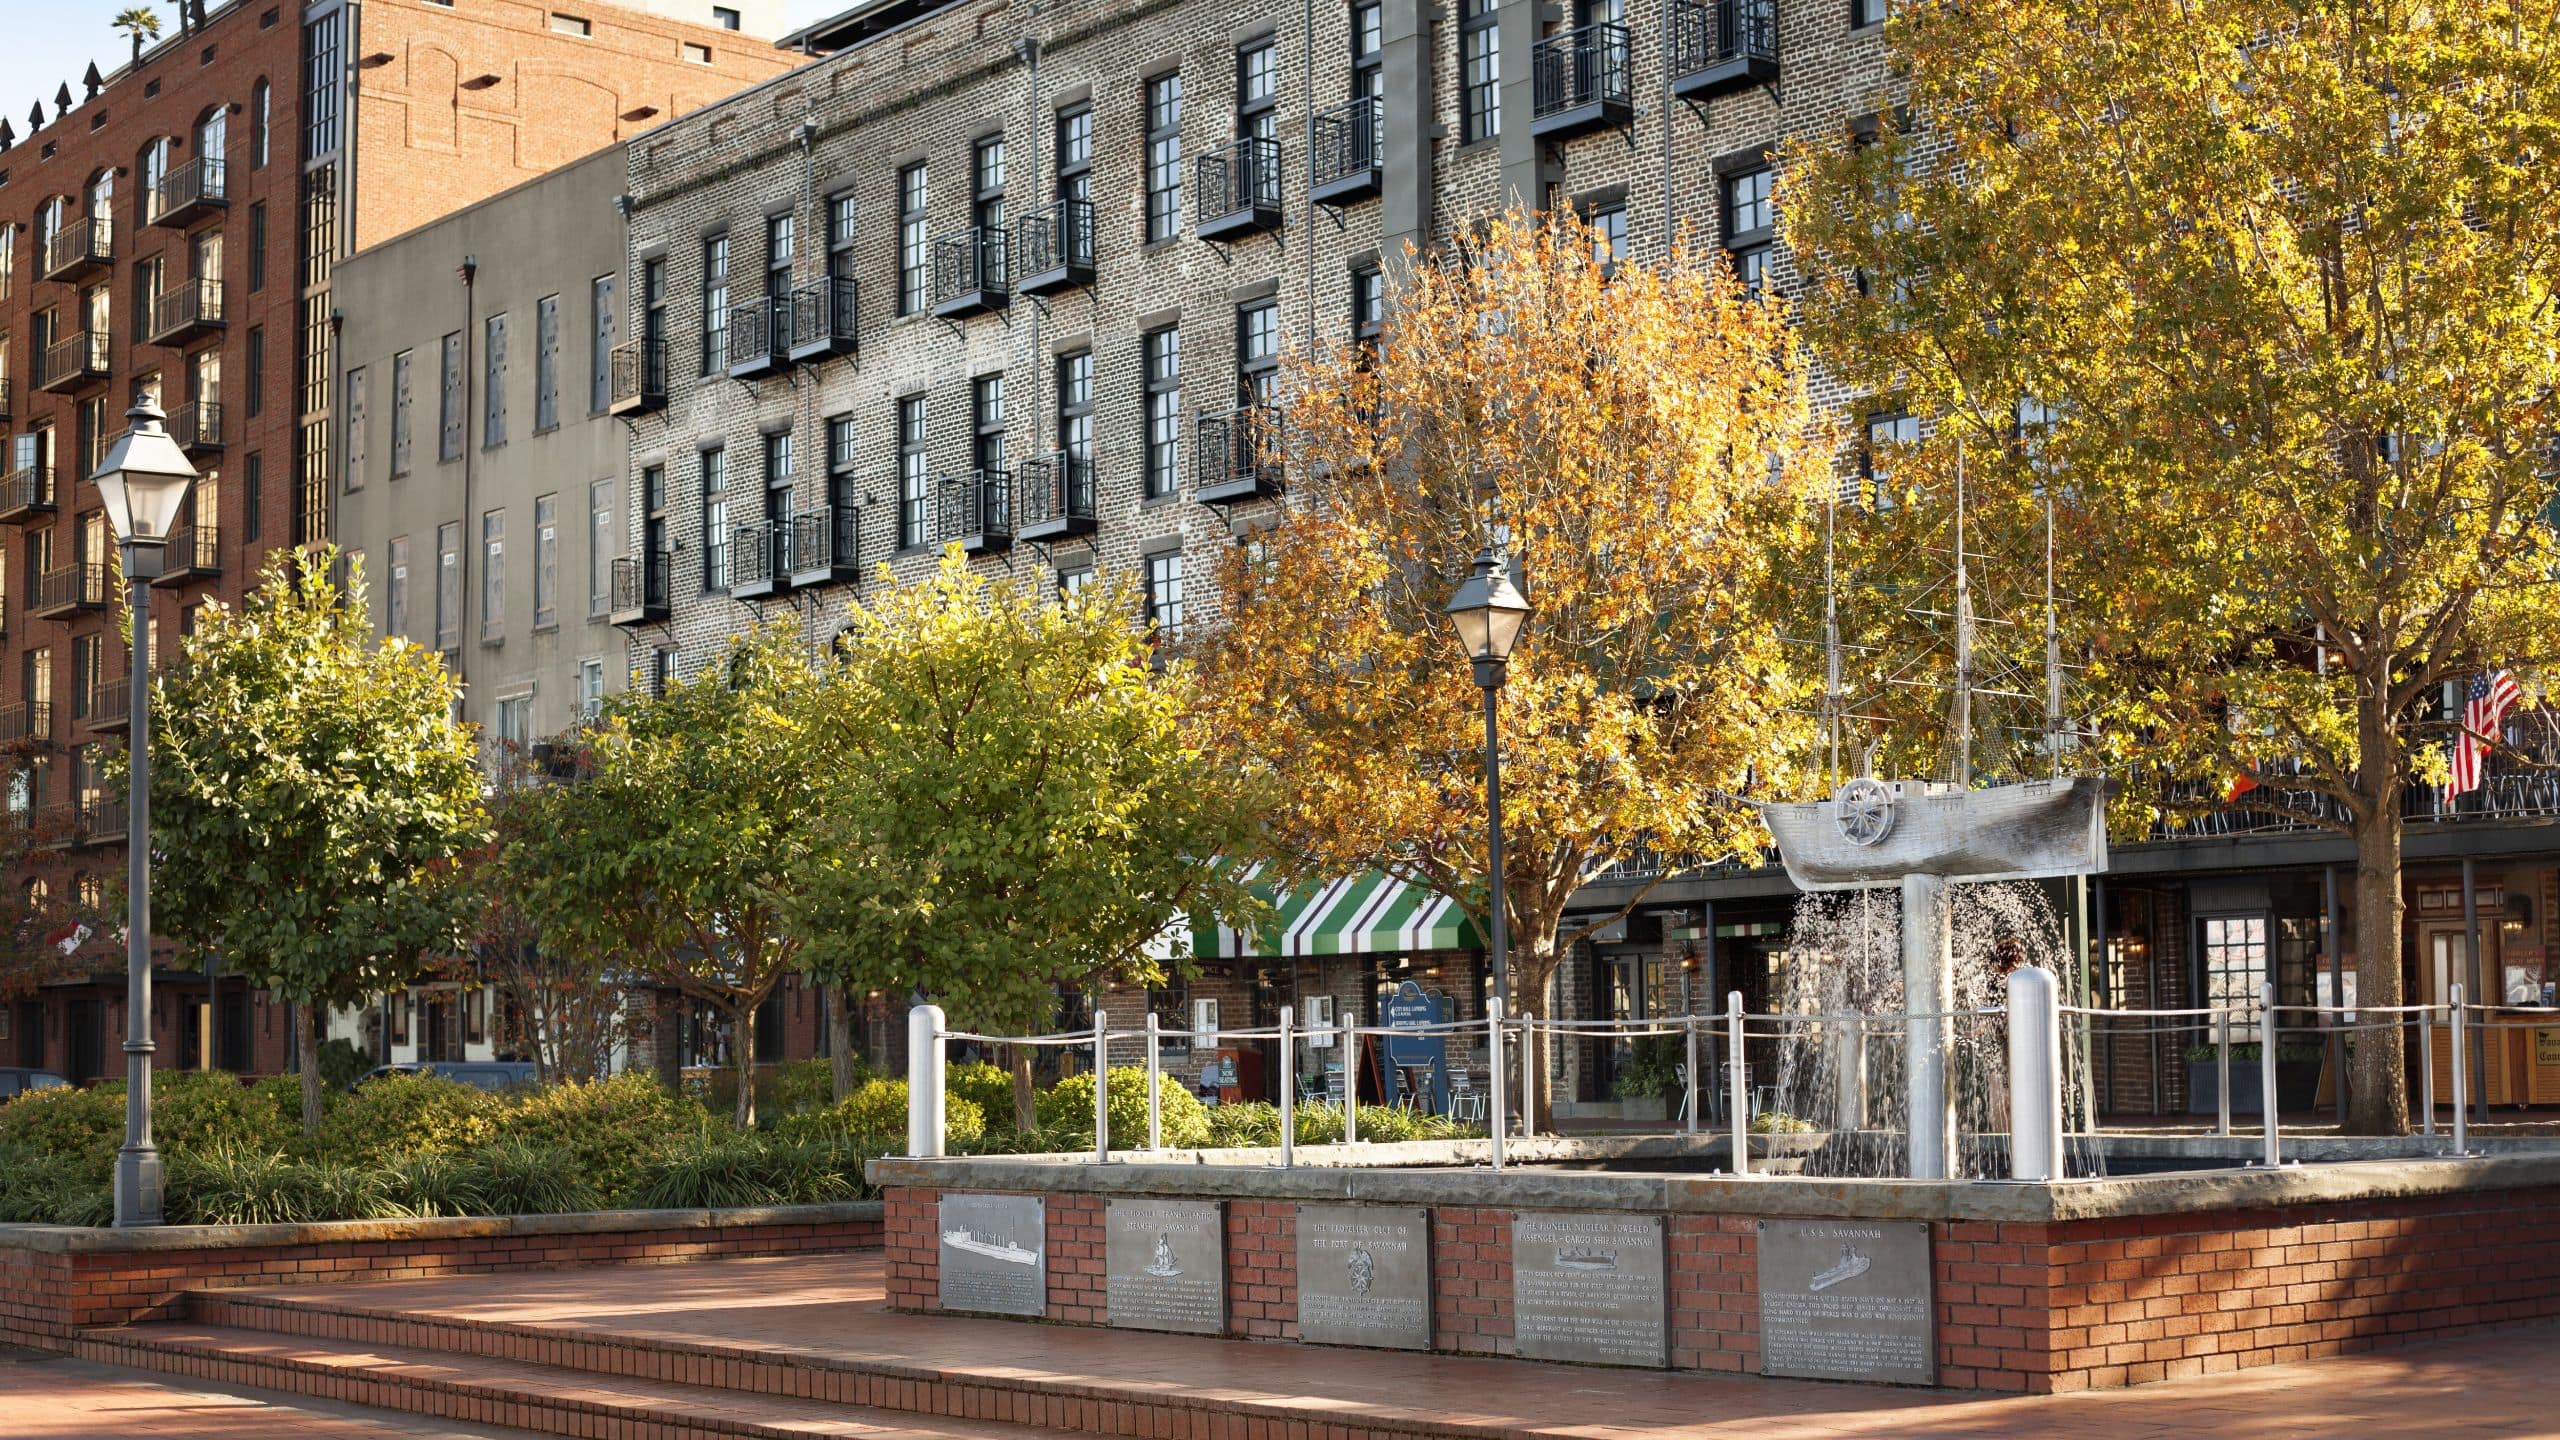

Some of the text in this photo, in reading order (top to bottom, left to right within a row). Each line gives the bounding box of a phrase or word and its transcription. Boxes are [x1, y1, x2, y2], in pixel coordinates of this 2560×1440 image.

[1523, 1221, 1650, 1234] THE PIONEER NUCLEAR POWERED
[1832, 1229, 1882, 1239] SAVANNAH
[1313, 1239, 1326, 1248] THE
[1353, 1240, 1363, 1249] OF
[1369, 1241, 1408, 1251] SAVANNAH
[1565, 1235, 1591, 1245] CARGO
[1593, 1236, 1609, 1245] SHIP
[1612, 1236, 1654, 1247] SAVANNAH
